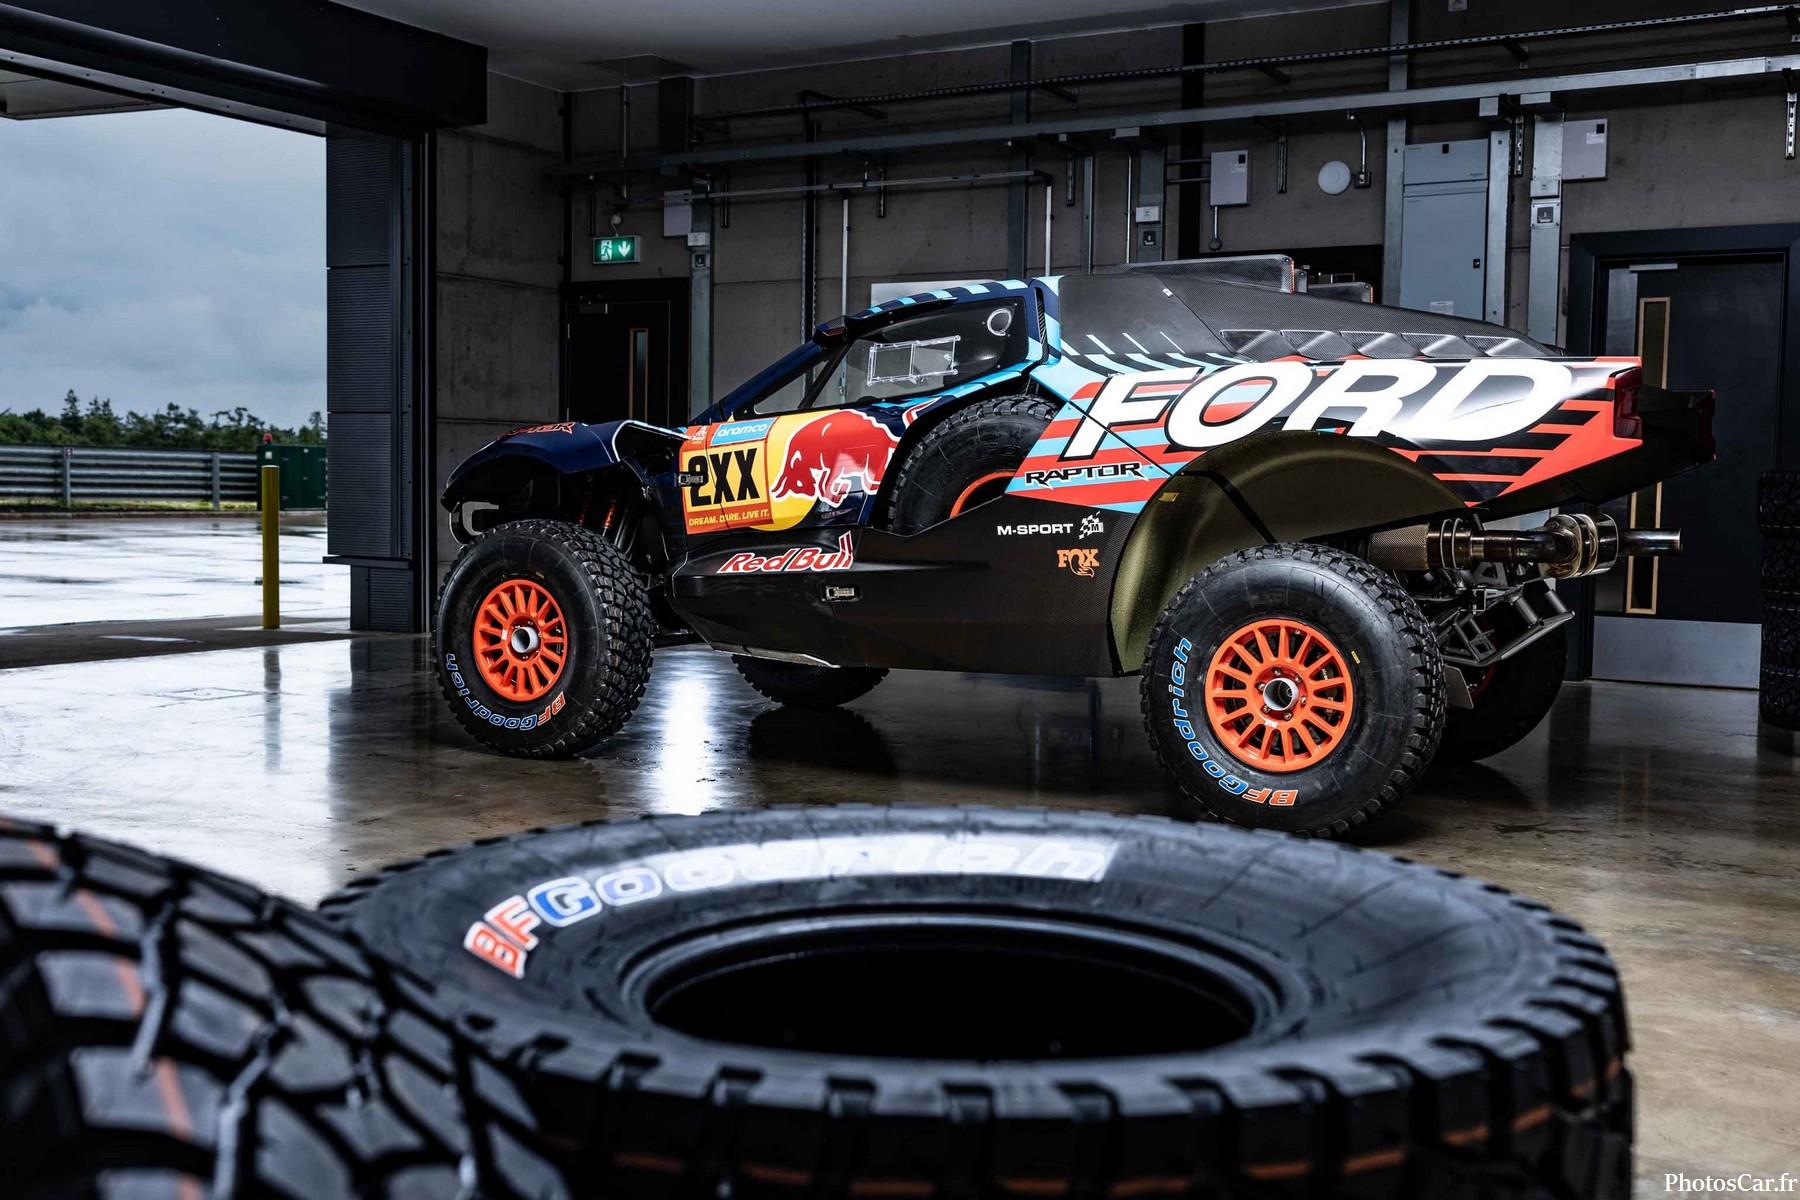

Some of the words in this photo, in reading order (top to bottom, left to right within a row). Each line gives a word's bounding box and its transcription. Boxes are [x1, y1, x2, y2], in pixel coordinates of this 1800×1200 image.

[1062, 358, 1572, 461] FORD
[717, 424, 768, 437] aramco
[687, 447, 760, 507] 2XX
[1025, 463, 1149, 490] RAPTOR
[689, 515, 719, 526] DREAM.
[719, 512, 742, 523] DARE.
[742, 510, 759, 520] LIVE
[760, 509, 770, 517] IT.
[997, 523, 1074, 536] M-SPORT
[1057, 549, 1100, 577] FOX
[445, 653, 566, 731] BFGoodrich
[1169, 637, 1299, 807] BFGoodrich
